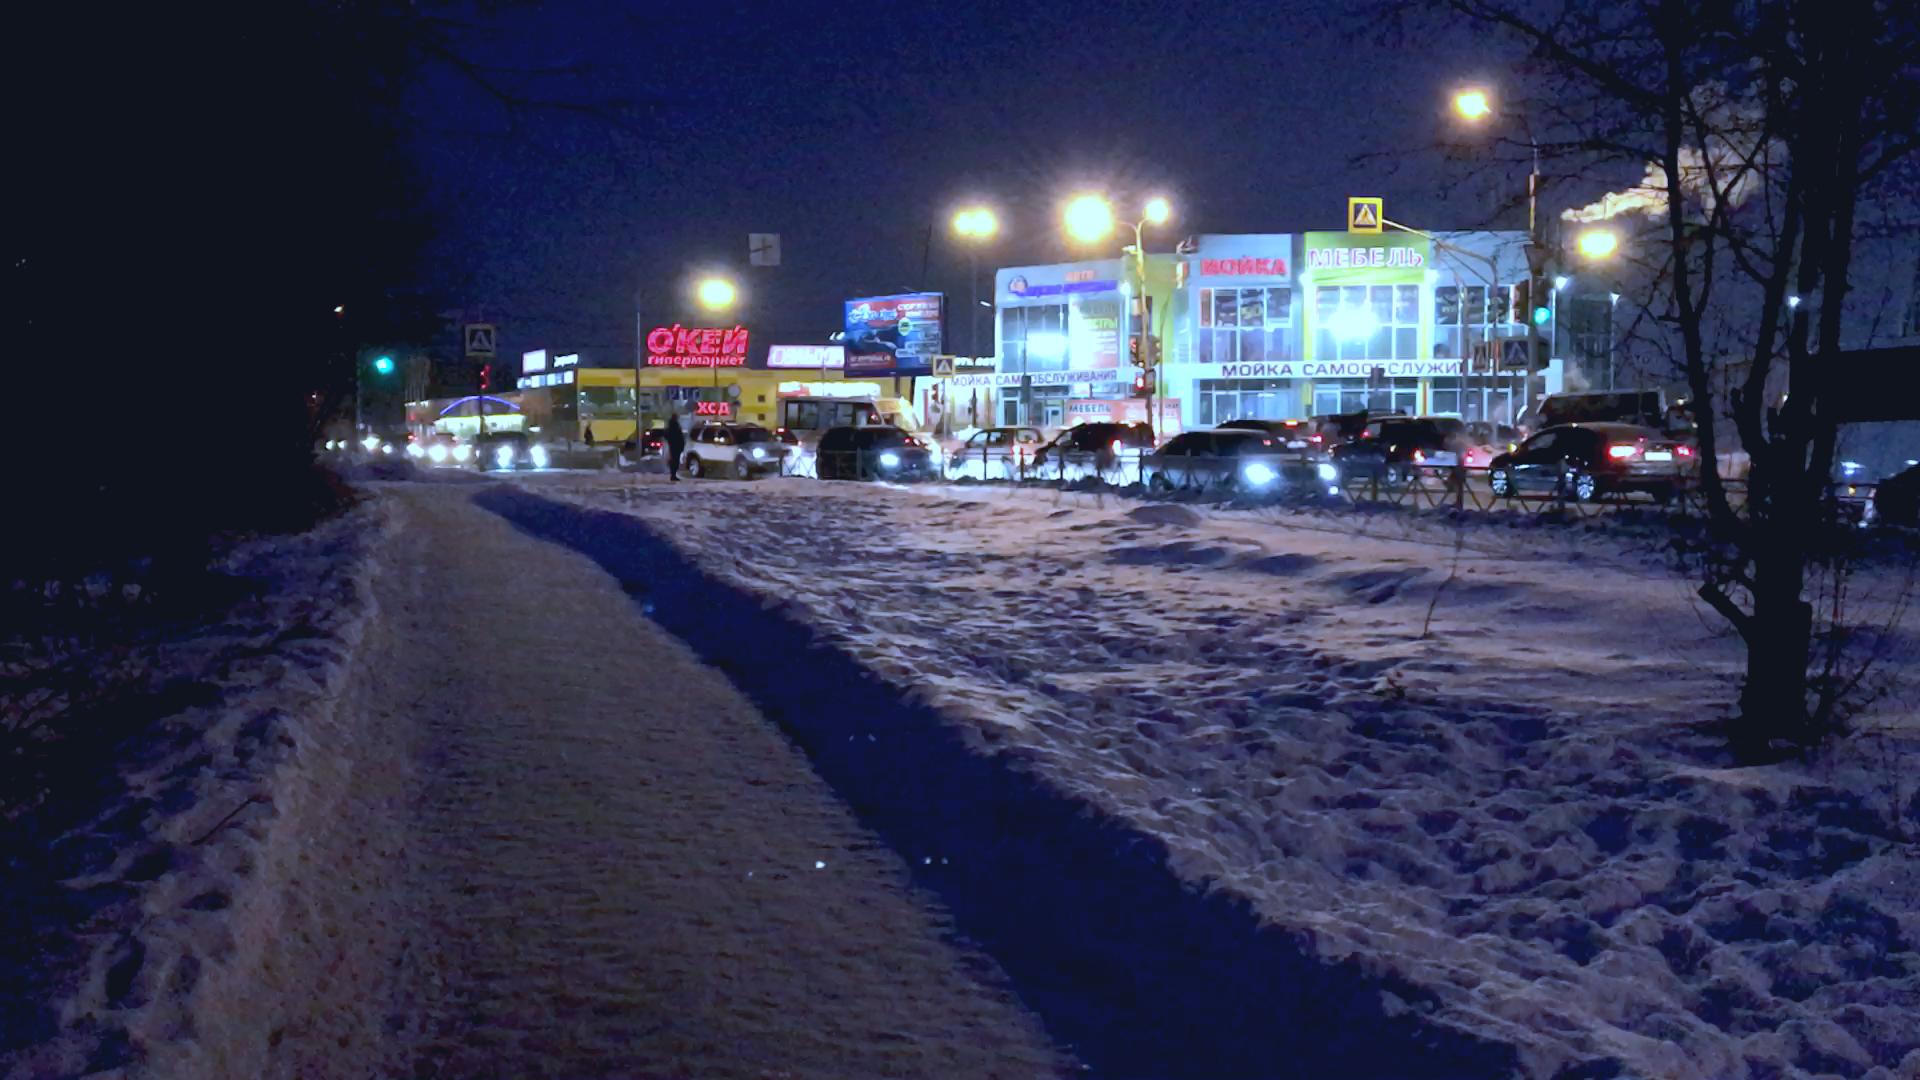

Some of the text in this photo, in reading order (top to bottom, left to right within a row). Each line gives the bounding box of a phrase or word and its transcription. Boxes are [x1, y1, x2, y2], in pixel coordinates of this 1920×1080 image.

[1307, 247, 1424, 268] МЕБЕЛЬ
[1201, 256, 1288, 276] МОЙКА
[647, 355, 746, 368] гипермаркет
[1222, 362, 1459, 377] МОЙКА САМООСЛУЖИ
[951, 370, 1117, 387] МОЙКА САМОБСЛУЖИВАНИЯ
[1068, 403, 1112, 413] МЕБЕЛЬ
